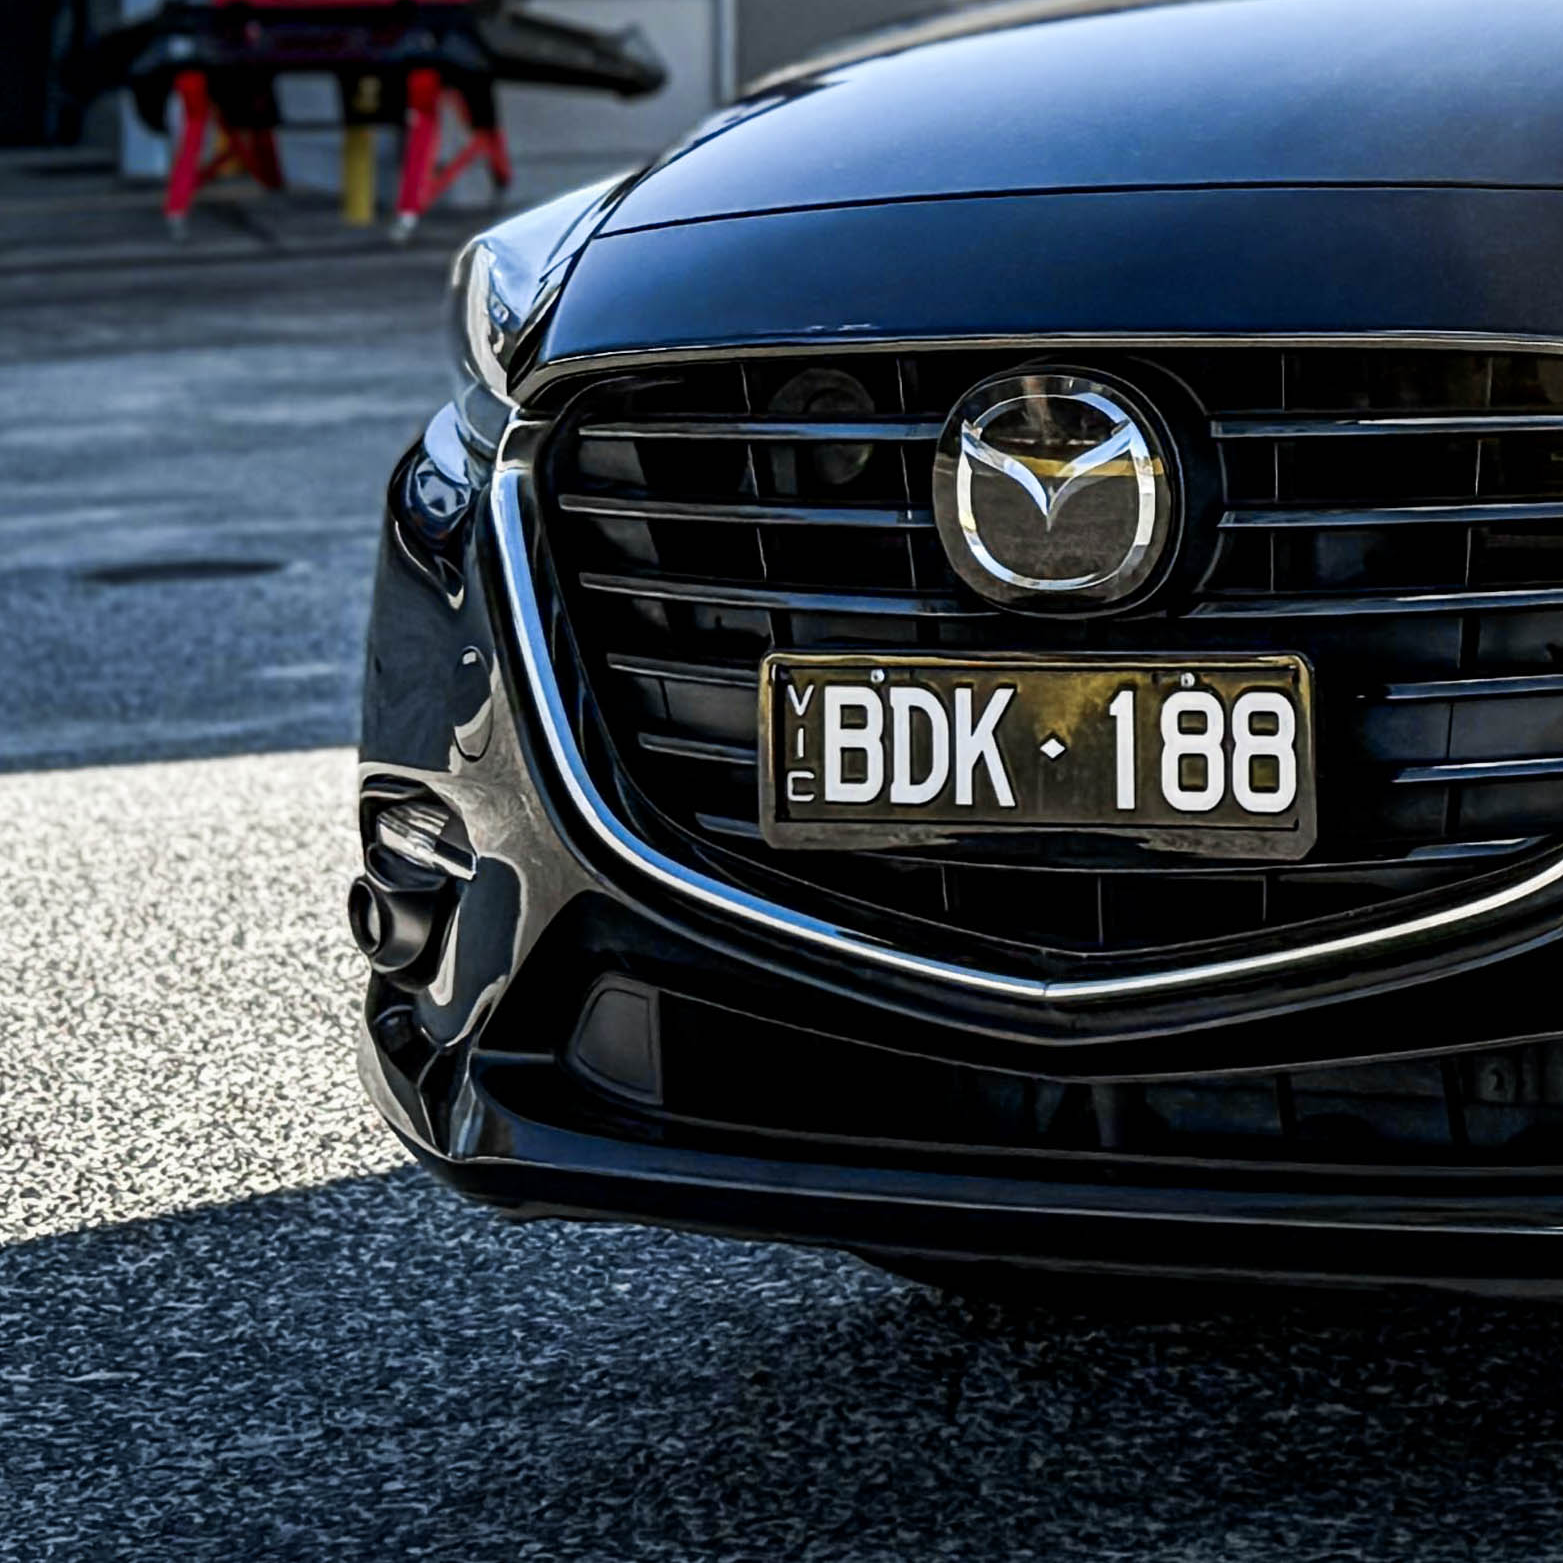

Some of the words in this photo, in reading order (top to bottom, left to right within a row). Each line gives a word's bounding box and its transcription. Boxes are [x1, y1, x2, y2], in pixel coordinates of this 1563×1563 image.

[786, 684, 815, 803] VIC
[823, 685, 1017, 809] BDK
[1108, 689, 1297, 813] 188
